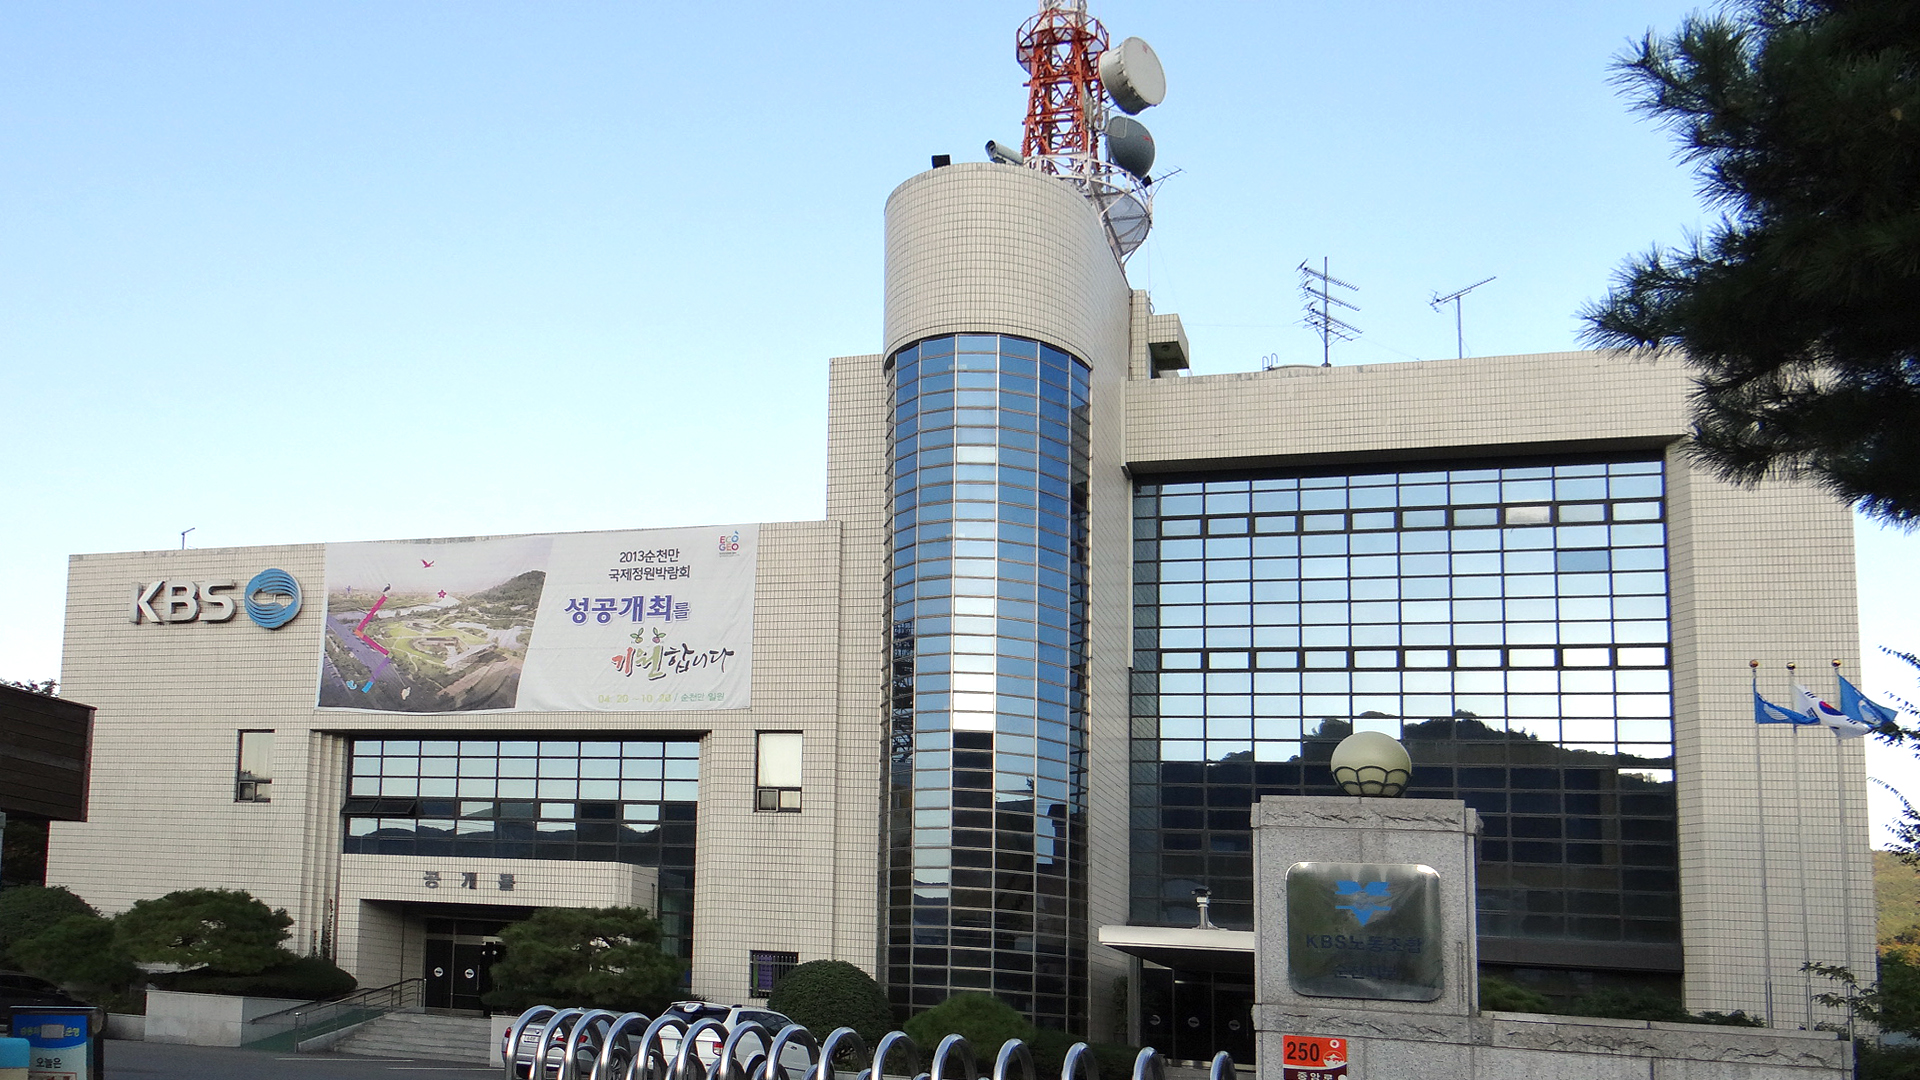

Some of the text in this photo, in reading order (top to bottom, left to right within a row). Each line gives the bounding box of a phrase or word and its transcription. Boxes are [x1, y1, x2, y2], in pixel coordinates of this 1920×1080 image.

[620, 548, 680, 563] 2013순천만
[719, 543, 739, 552] GEO
[608, 565, 691, 582] 국제정원박람회
[130, 579, 237, 625] KBS
[564, 594, 691, 624] 성공개최를
[611, 643, 735, 681] 기원합니다
[1286, 1041, 1320, 1062] 250
[36, 1057, 62, 1069] 오늘은
